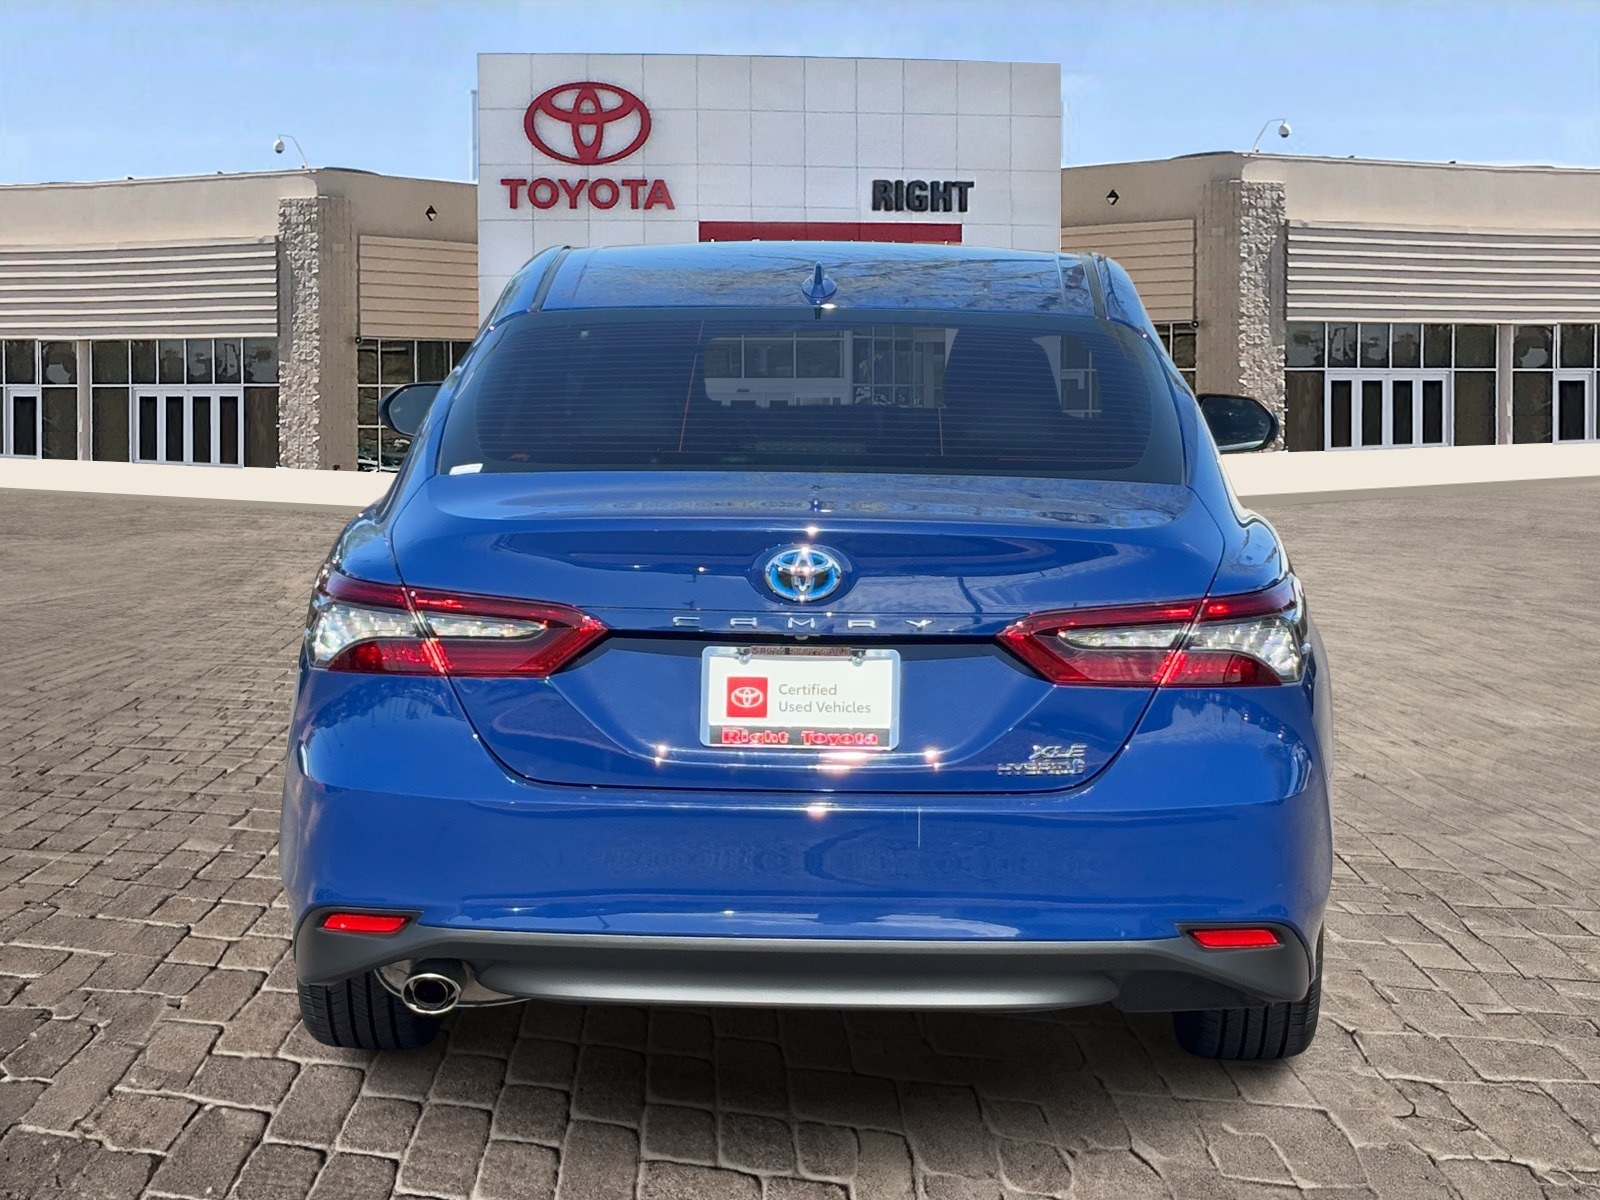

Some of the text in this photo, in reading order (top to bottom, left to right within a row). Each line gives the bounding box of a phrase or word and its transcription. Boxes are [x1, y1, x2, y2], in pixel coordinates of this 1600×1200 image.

[500, 178, 675, 210] TOYOTA
[870, 179, 975, 213] RIGHT
[672, 616, 934, 631] CAMRY
[778, 683, 838, 696] Certified
[778, 700, 872, 714] Used Vehicles
[721, 726, 879, 745] Right Toyota
[1028, 743, 1088, 760] XLE
